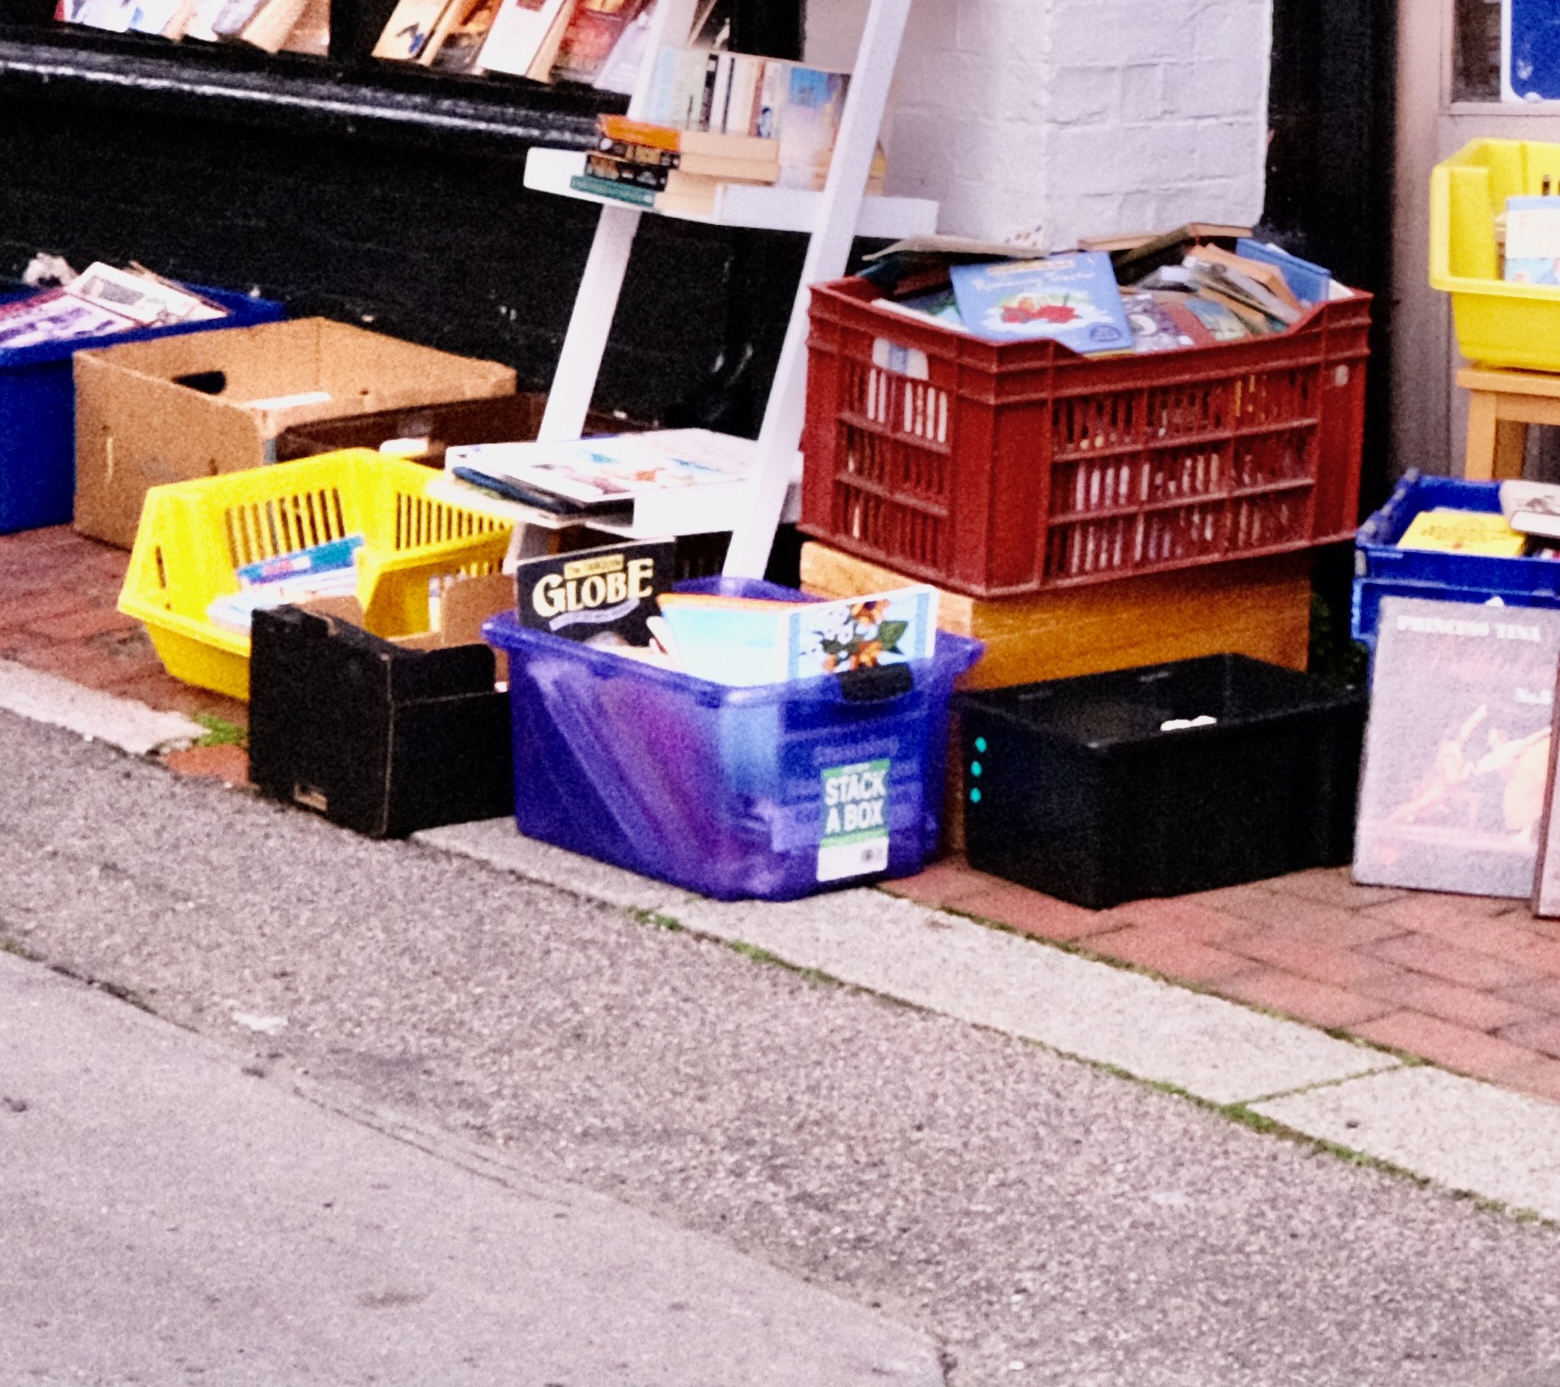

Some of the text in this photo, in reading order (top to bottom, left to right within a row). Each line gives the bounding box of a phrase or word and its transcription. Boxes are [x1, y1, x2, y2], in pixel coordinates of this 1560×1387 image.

[532, 557, 654, 617] GLOBE
[824, 770, 887, 807] STACK
[826, 798, 885, 835] A BOX
